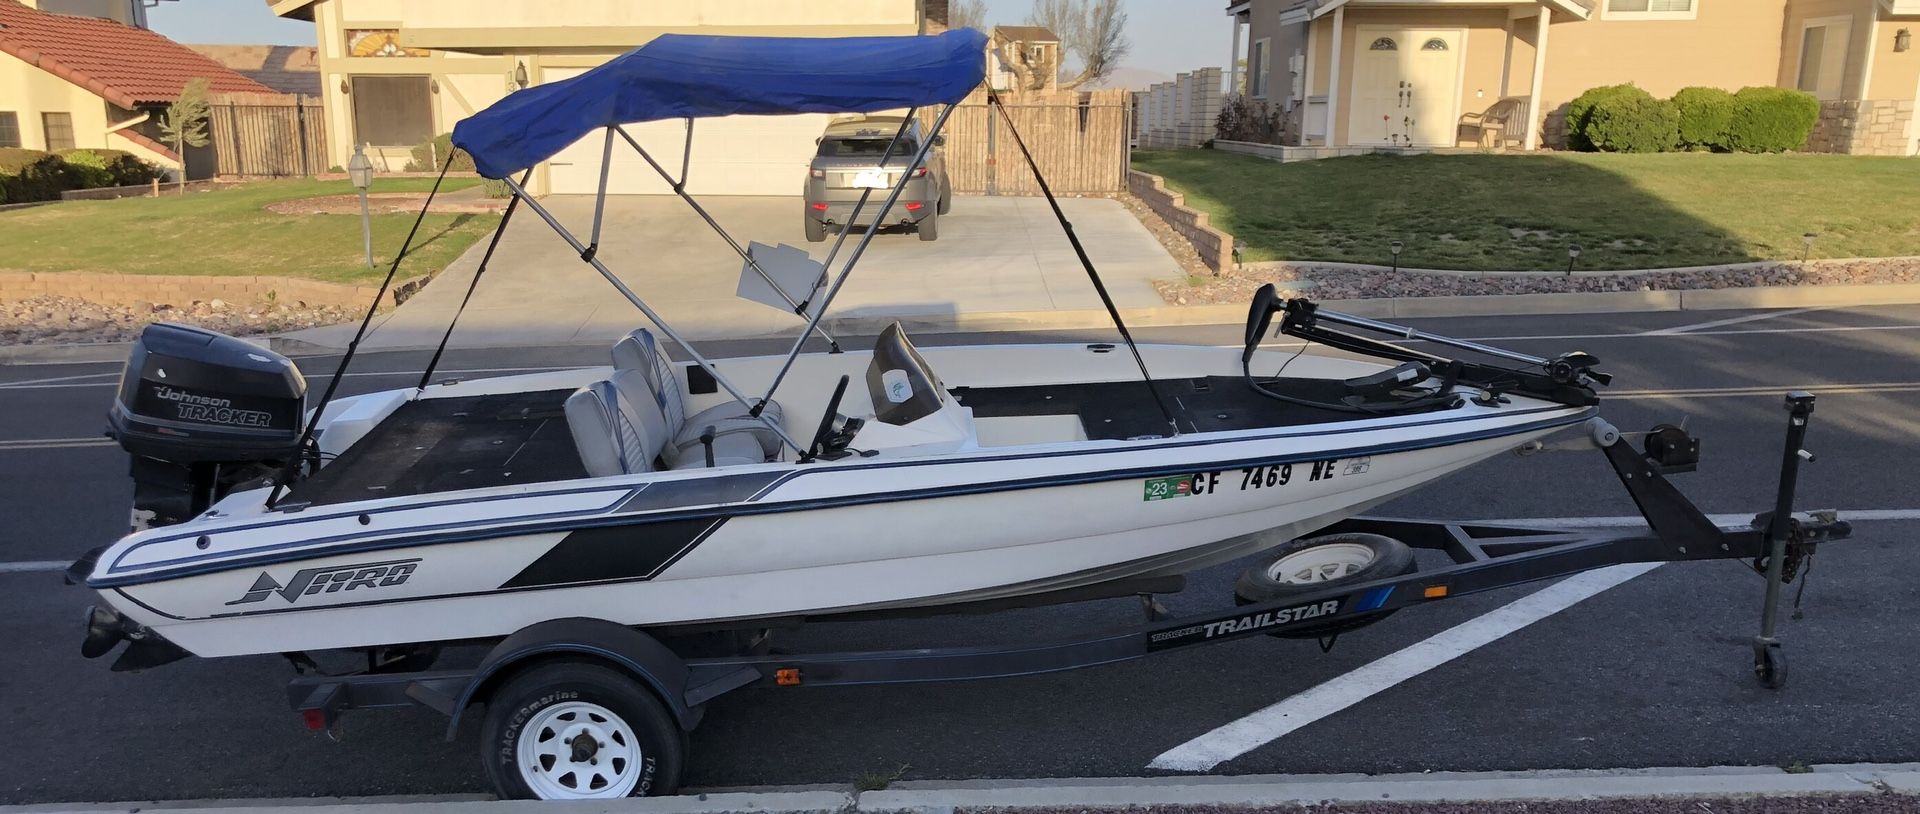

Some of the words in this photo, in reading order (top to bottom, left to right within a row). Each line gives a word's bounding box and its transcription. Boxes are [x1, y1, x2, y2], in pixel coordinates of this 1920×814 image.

[153, 386, 231, 407] Johnson
[178, 403, 272, 427] TRACKER
[1151, 482, 1168, 496] 23
[1191, 472, 1220, 495] CF
[1240, 464, 1292, 490] 7469
[1309, 460, 1337, 482] NE
[224, 557, 423, 605] NITRO
[1203, 600, 1339, 637] TRAILSTAR
